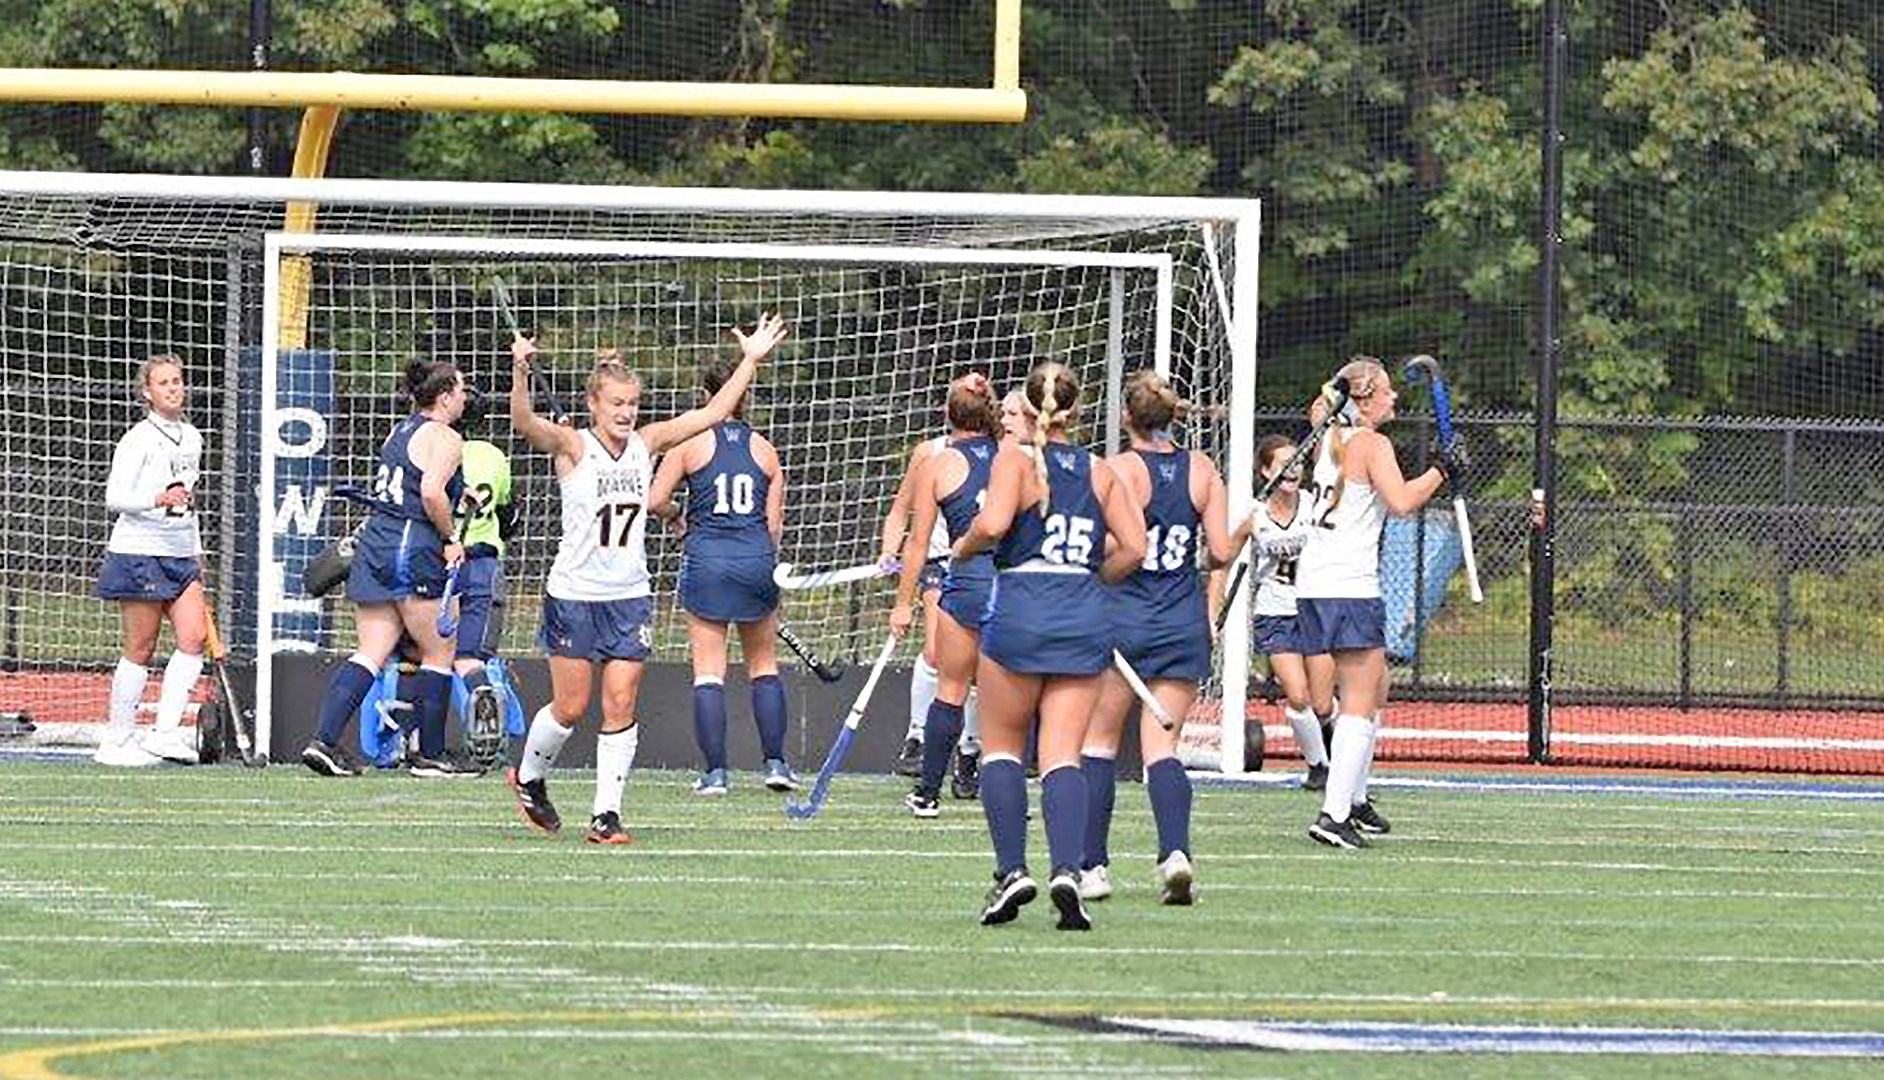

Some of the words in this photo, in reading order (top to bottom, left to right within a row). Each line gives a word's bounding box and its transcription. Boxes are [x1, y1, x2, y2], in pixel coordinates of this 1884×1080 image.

[375, 464, 404, 505] 24
[713, 473, 754, 514] 10
[596, 503, 640, 547] 17
[1041, 513, 1094, 564] 25
[1142, 524, 1191, 570] 18
